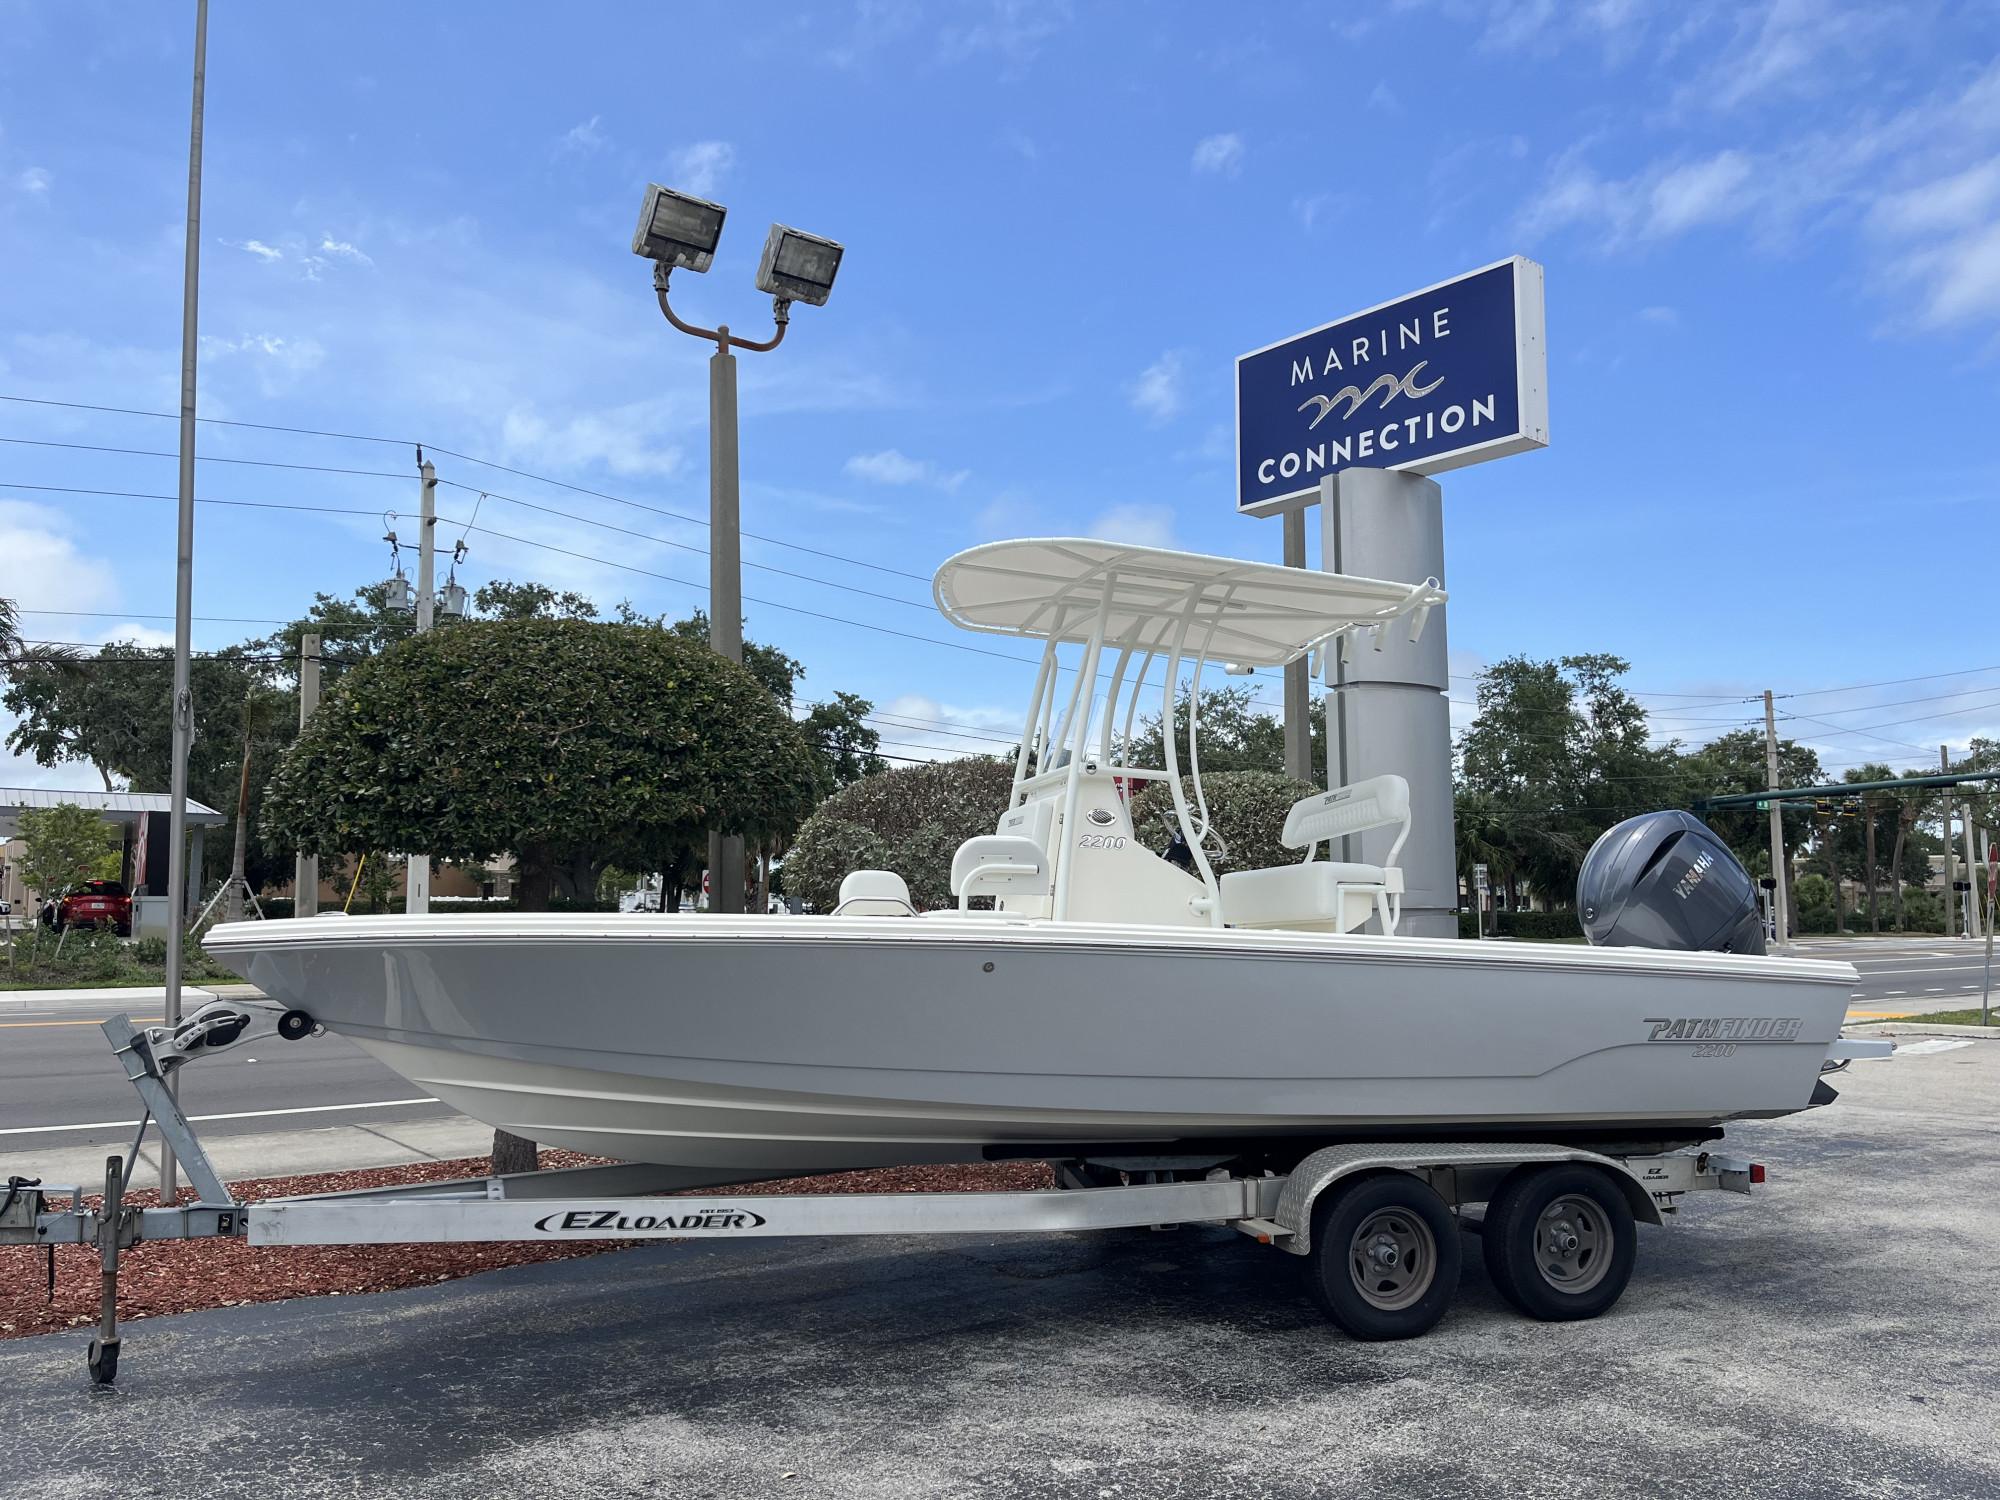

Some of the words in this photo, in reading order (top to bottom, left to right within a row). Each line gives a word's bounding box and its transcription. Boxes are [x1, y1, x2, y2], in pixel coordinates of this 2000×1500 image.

[1291, 307, 1451, 386] MARINE
[1258, 394, 1496, 484] CONNECTION
[1079, 835, 1127, 849] 2200
[1673, 850, 1714, 899] YAMAHA
[1643, 1018, 1803, 1041] PATHFINDER
[1691, 1044, 1737, 1057] 2200
